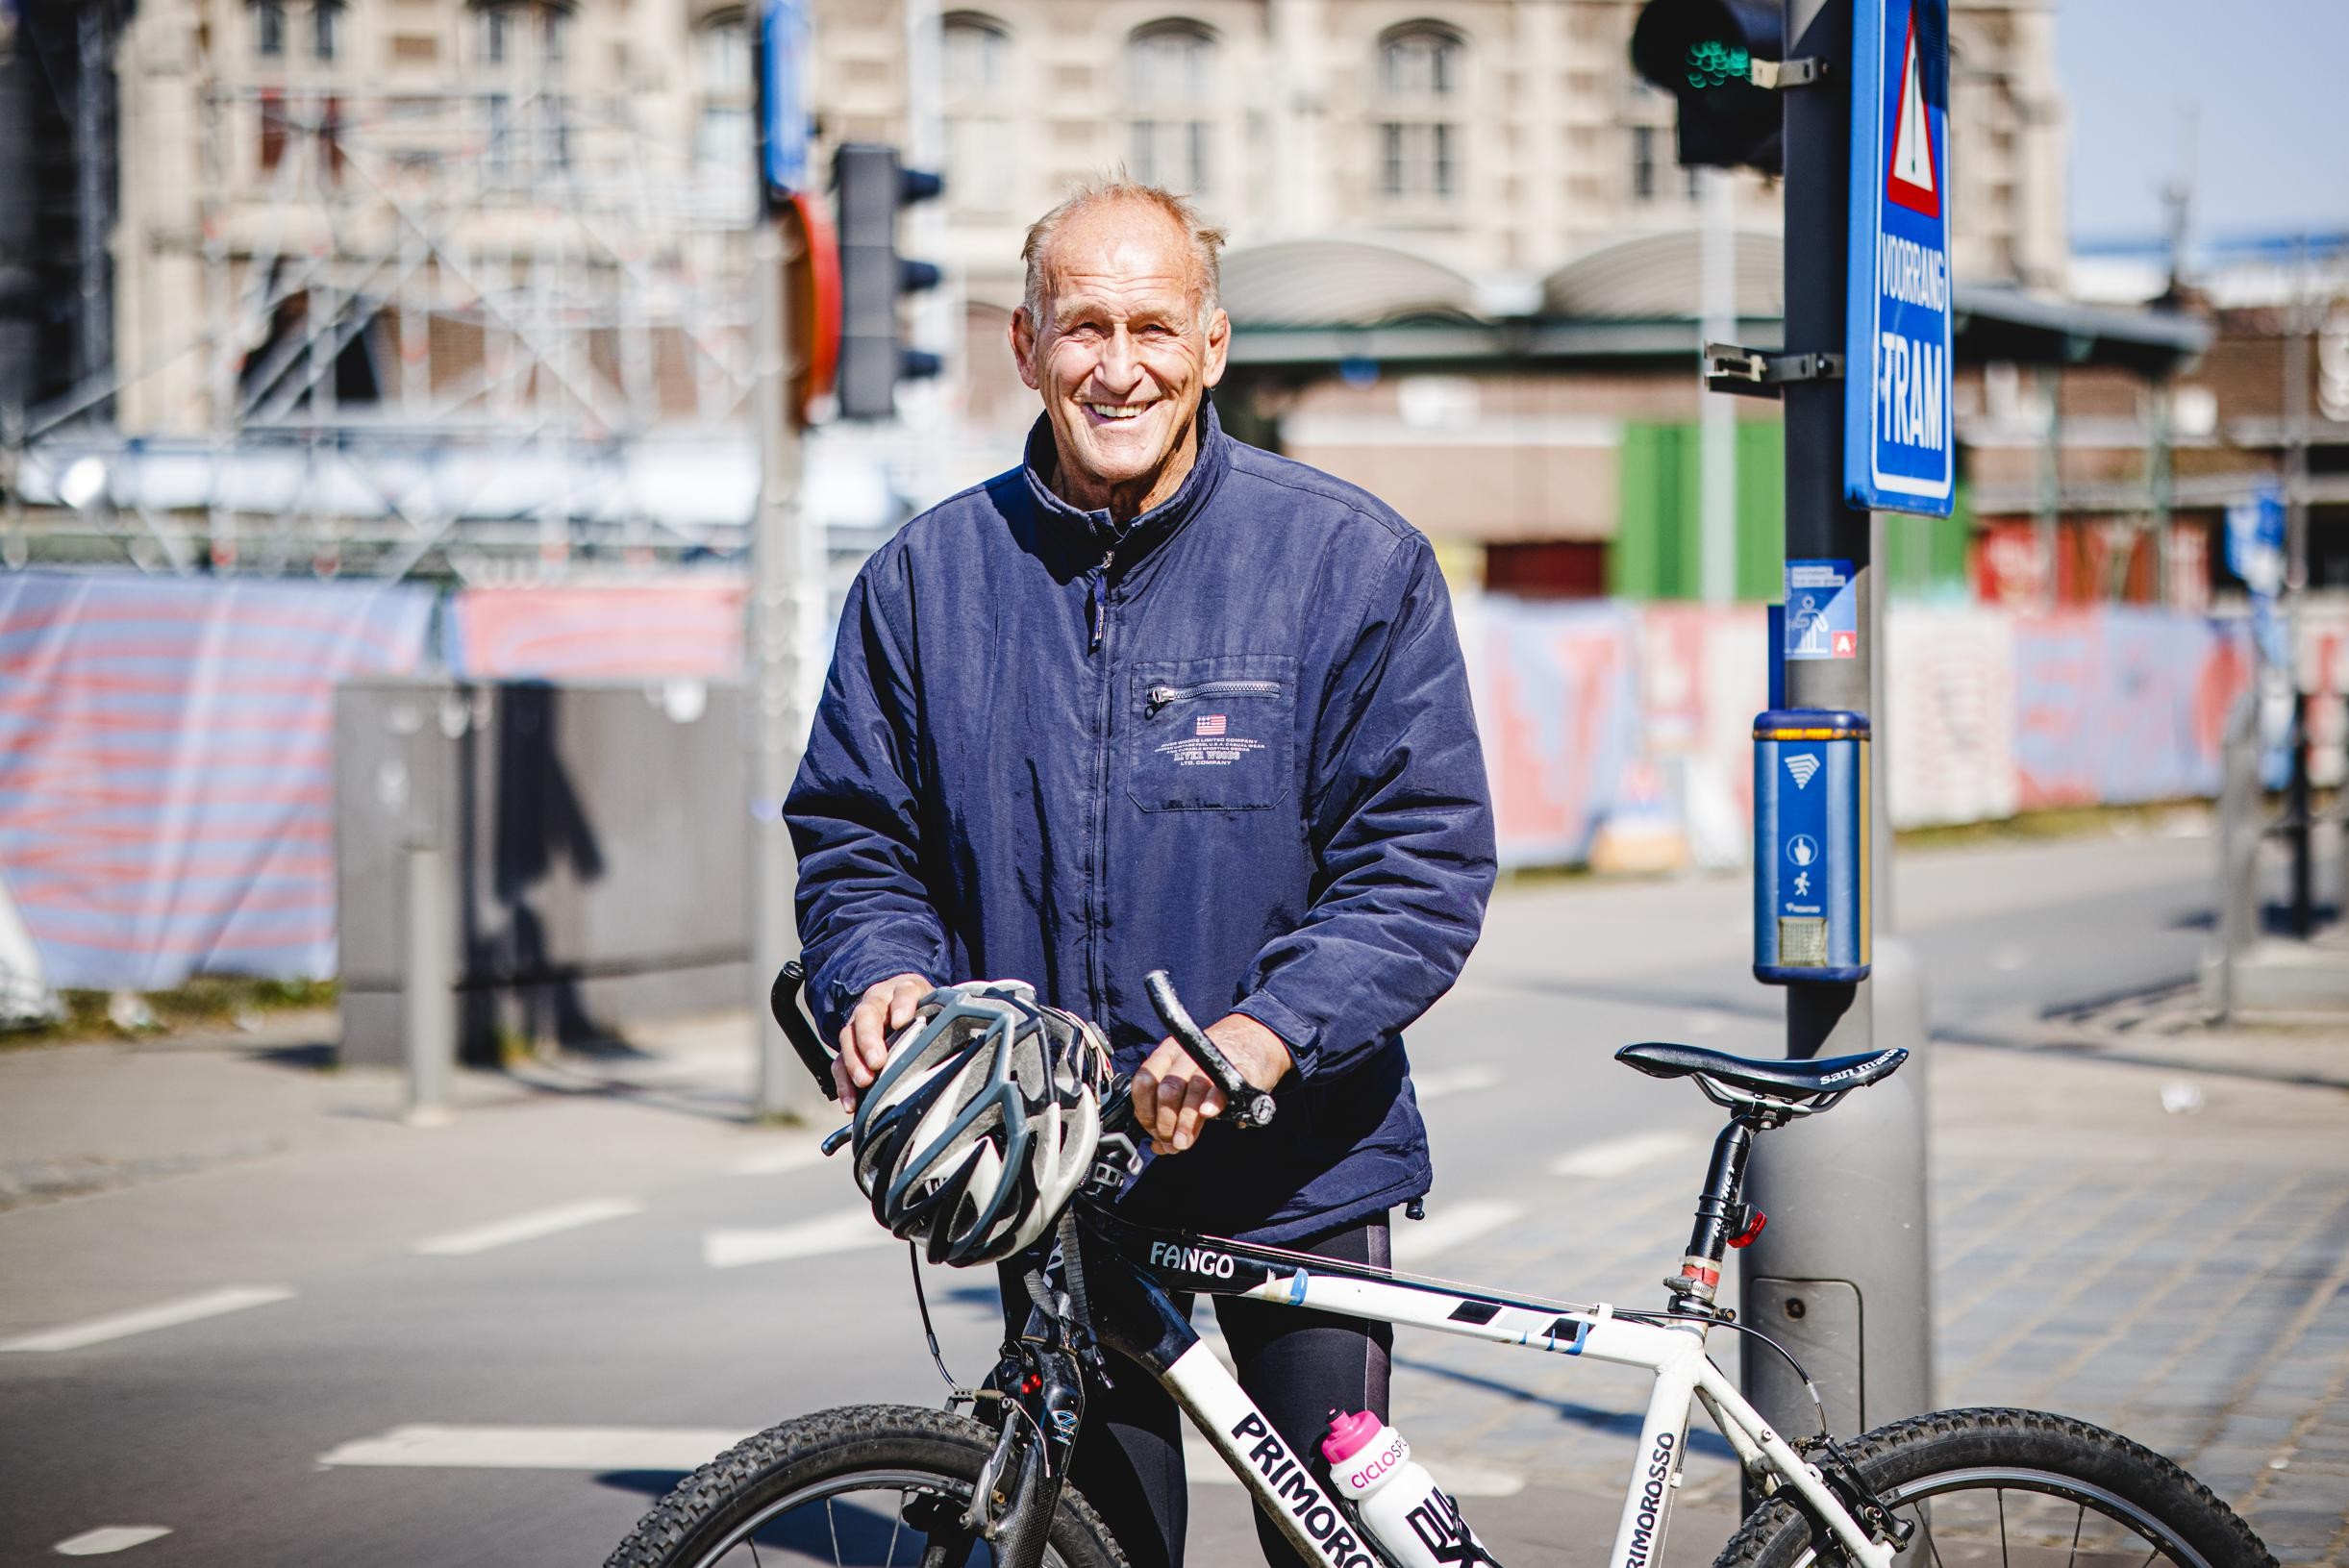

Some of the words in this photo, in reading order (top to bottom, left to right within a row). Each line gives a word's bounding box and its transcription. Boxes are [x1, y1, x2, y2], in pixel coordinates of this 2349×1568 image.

[1882, 232, 1944, 313] VOORRANG
[1882, 332, 1942, 452] TRAM
[1820, 1068, 1856, 1084] san
[1150, 1241, 1235, 1279] FANGO
